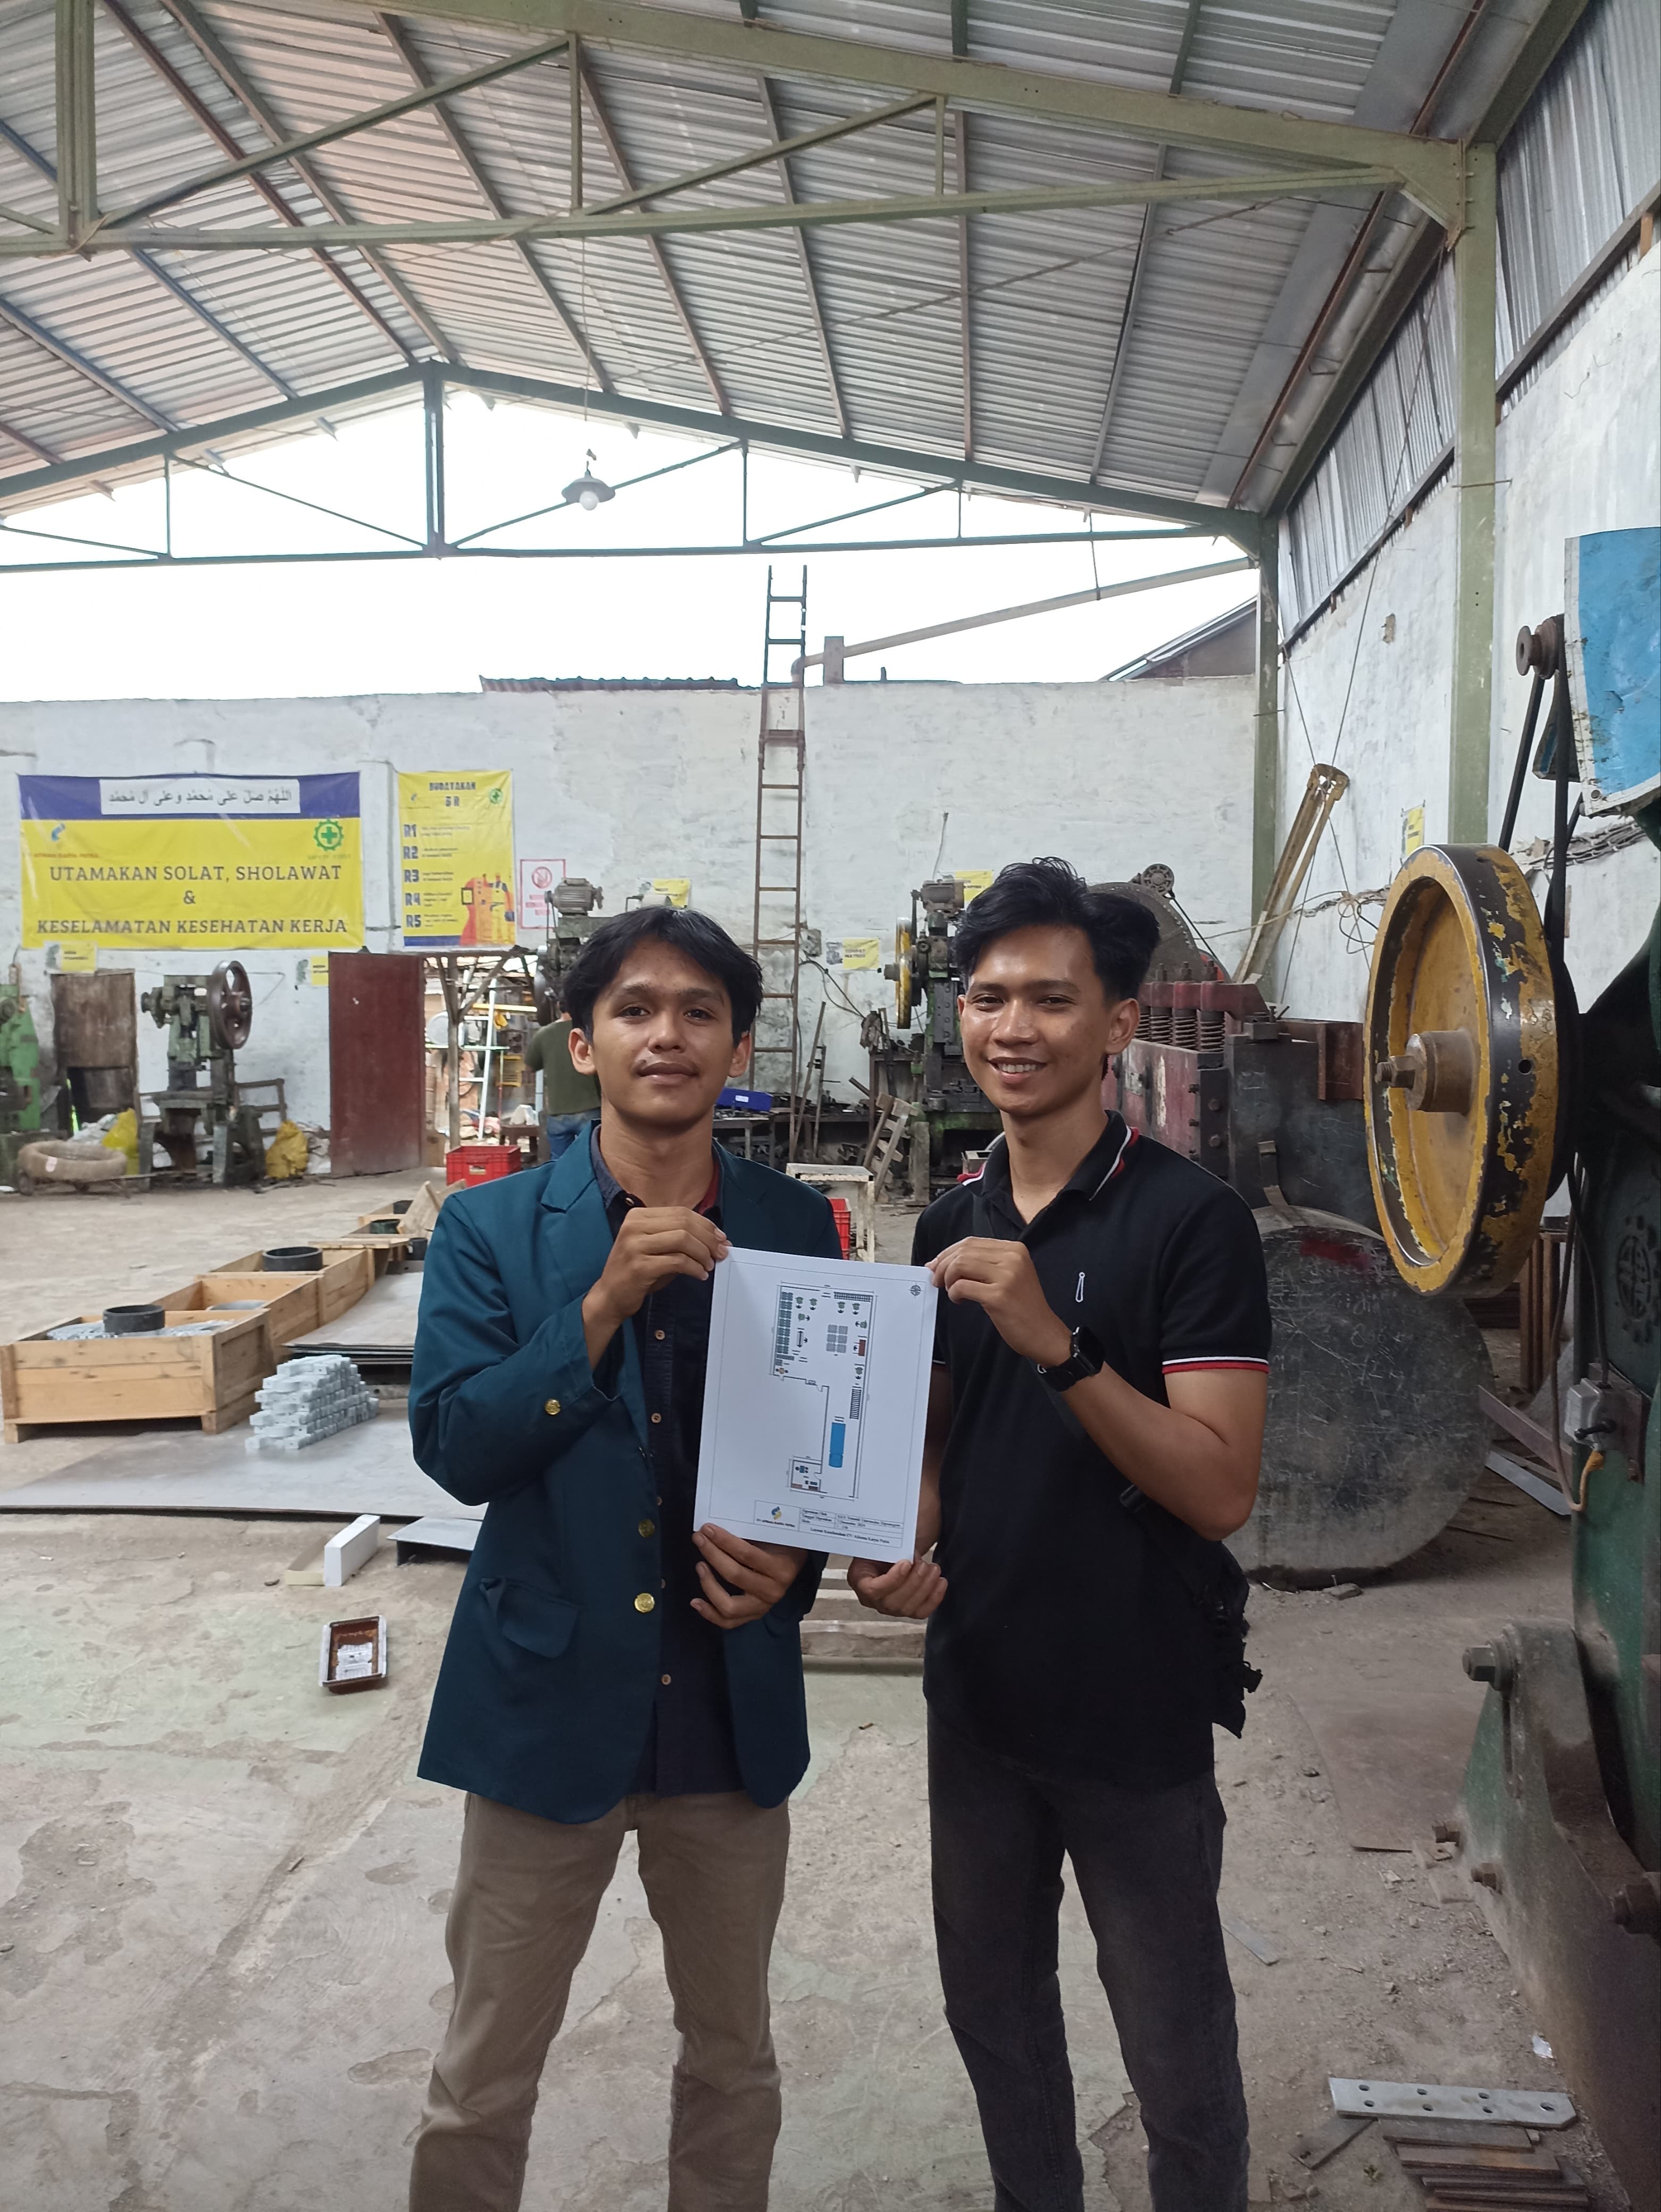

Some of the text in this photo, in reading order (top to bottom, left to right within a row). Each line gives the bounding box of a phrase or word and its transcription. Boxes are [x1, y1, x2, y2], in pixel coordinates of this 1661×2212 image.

[403, 824, 417, 837] R1
[403, 845, 419, 859] R2
[49, 865, 342, 883] UTAMAKAN SOLAT, SHOLAWAT
[404, 869, 419, 883] R3
[183, 890, 196, 904] &
[405, 893, 421, 906] R4
[37, 919, 347, 934] KESELAMATAN KESEHATAN KERJA
[406, 915, 421, 927] R5
